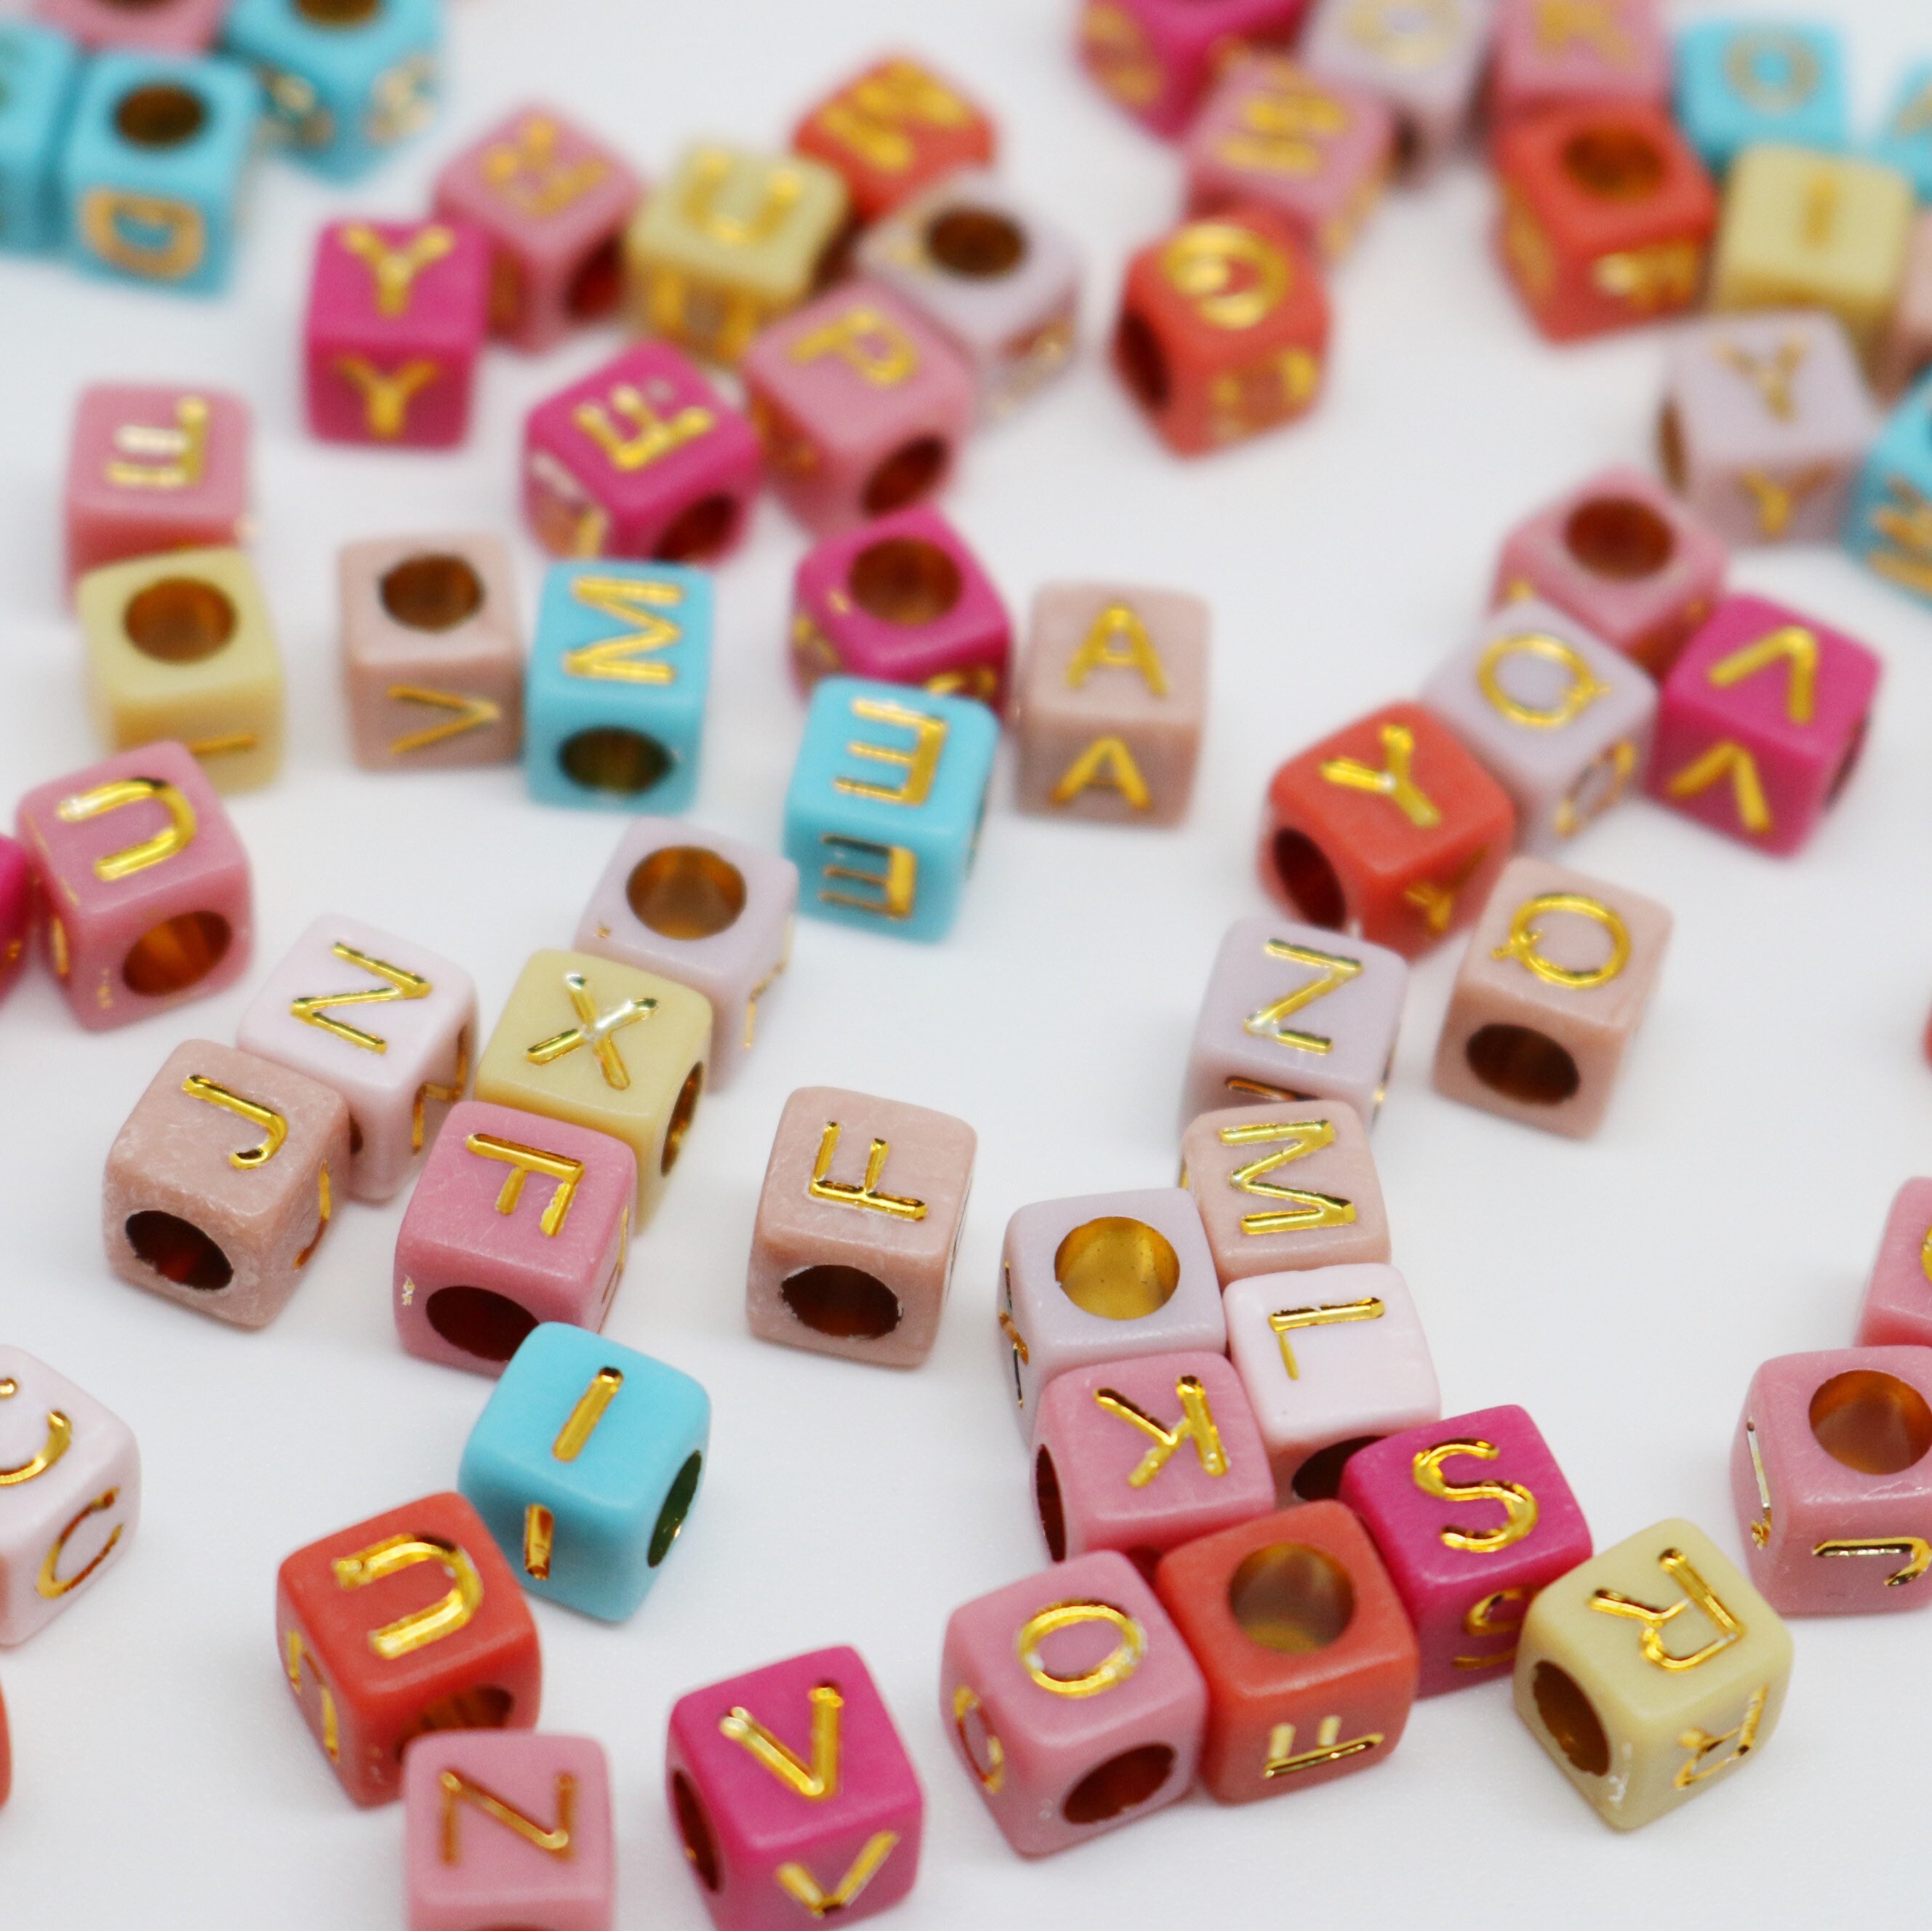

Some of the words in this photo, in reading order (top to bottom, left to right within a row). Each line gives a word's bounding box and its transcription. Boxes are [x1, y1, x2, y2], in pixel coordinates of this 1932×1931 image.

[338, 224, 458, 318] Y
[791, 305, 918, 387] P
[1715, 331, 1807, 423] Y
[107, 396, 209, 489] F
[334, 358, 436, 436] Y
[1065, 603, 1169, 698] A
[1476, 633, 1611, 731] Q
[834, 696, 949, 807] E
[1047, 734, 1153, 811] A
[1318, 723, 1442, 829] Y
[57, 776, 198, 881] U
[819, 831, 918, 922] E
[1491, 892, 1632, 990] Q
[527, 971, 660, 1089] X
[180, 1072, 289, 1171] J
[464, 1131, 585, 1237] F
[807, 1120, 929, 1223] F
[1218, 1118, 1357, 1236] M
[1267, 1296, 1386, 1381] L
[550, 1365, 625, 1463] I
[1094, 1374, 1231, 1488] K
[522, 1501, 556, 1581] I
[1412, 1436, 1539, 1554] S
[333, 1530, 484, 1661] U
[1587, 1546, 1745, 1674] R
[1811, 1535, 1932, 1588] J
[1019, 1597, 1149, 1700] O
[720, 1681, 845, 1803] V
[1264, 1714, 1386, 1781] F
[772, 1829, 902, 1921] V
